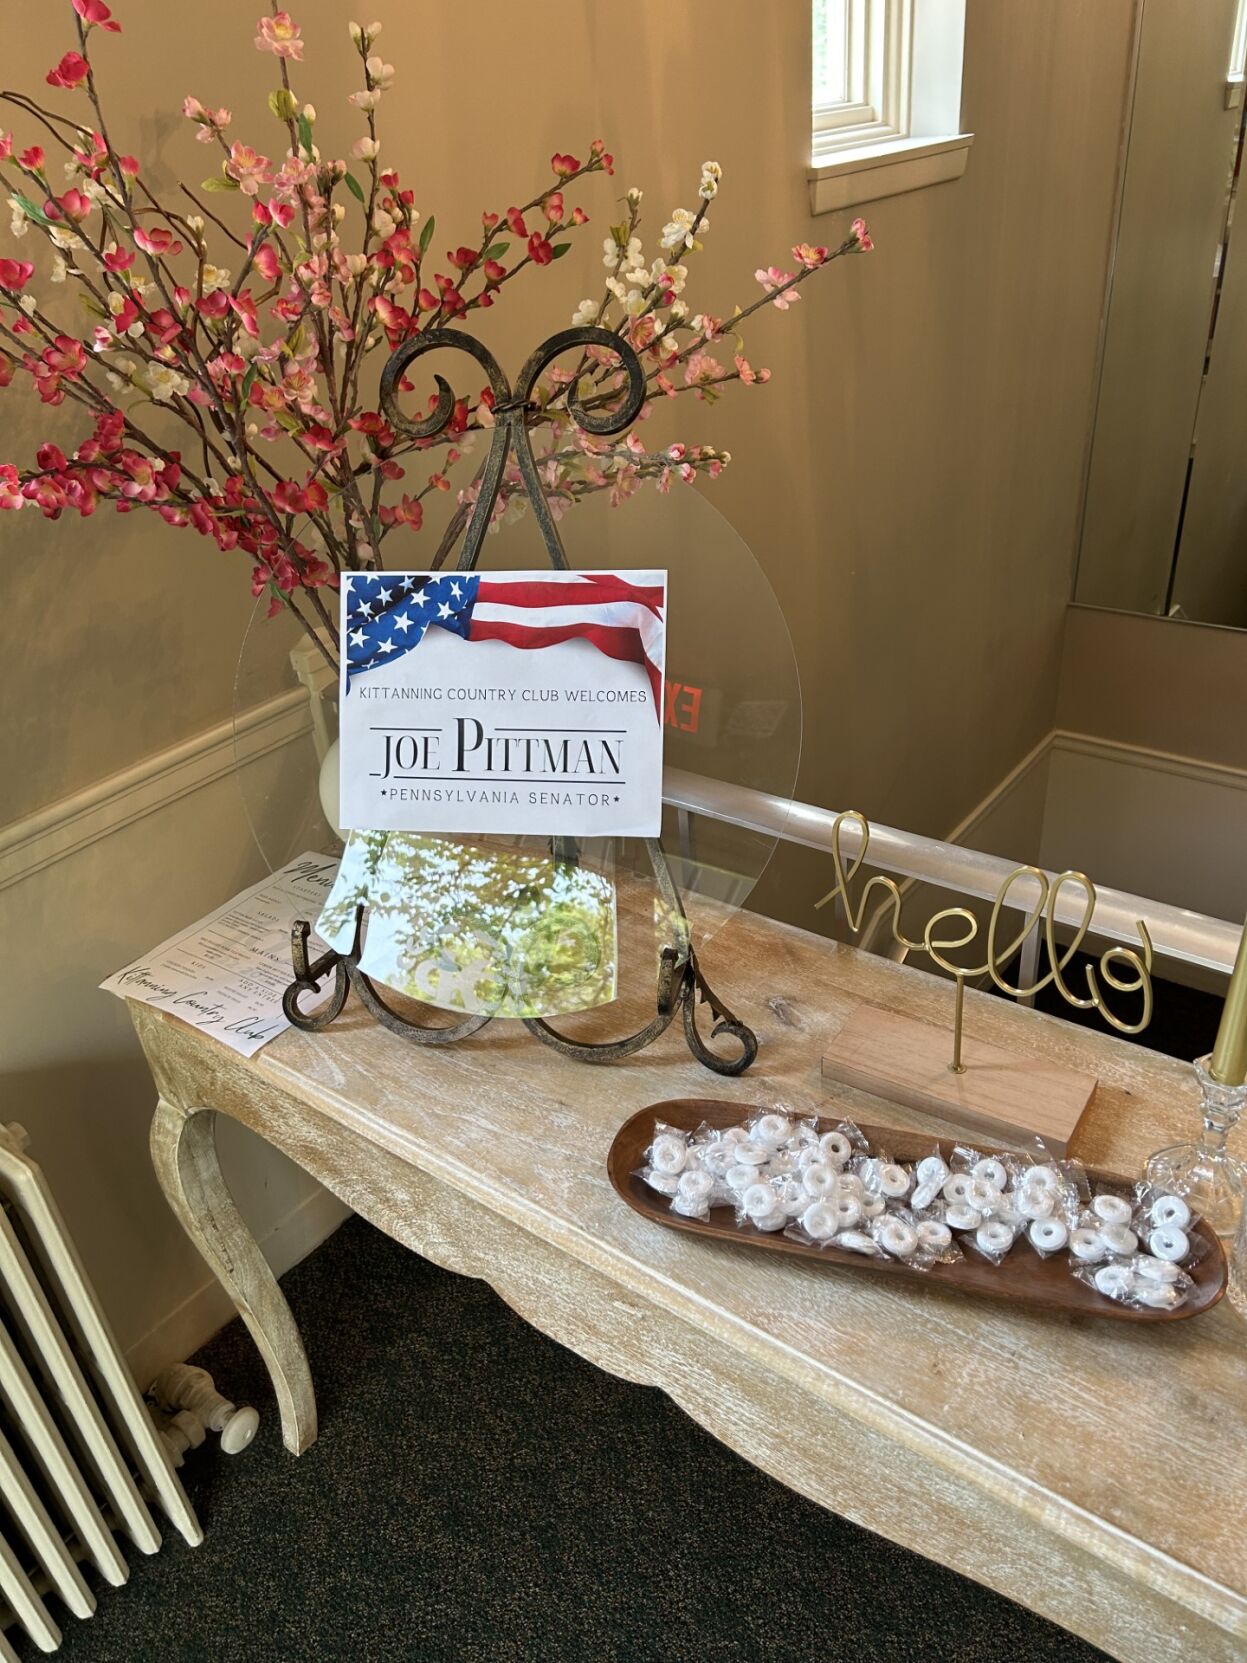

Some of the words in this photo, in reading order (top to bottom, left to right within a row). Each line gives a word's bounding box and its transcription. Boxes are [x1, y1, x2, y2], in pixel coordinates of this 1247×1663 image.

[359, 686, 443, 701] KITTANNING
[447, 688, 517, 702] COUNTRY
[522, 688, 560, 702] CLUB
[565, 690, 648, 704] WELCOMES
[379, 734, 441, 780] JOE
[451, 717, 624, 775] PITTMAN
[389, 787, 520, 804] PENNSYLVANIA
[528, 791, 611, 807] SENATOR
[814, 809, 1154, 1035] hello
[249, 946, 280, 961] MAINS
[118, 965, 178, 1001] Kittanning
[172, 991, 227, 1025] Country
[223, 1016, 280, 1041] Club
